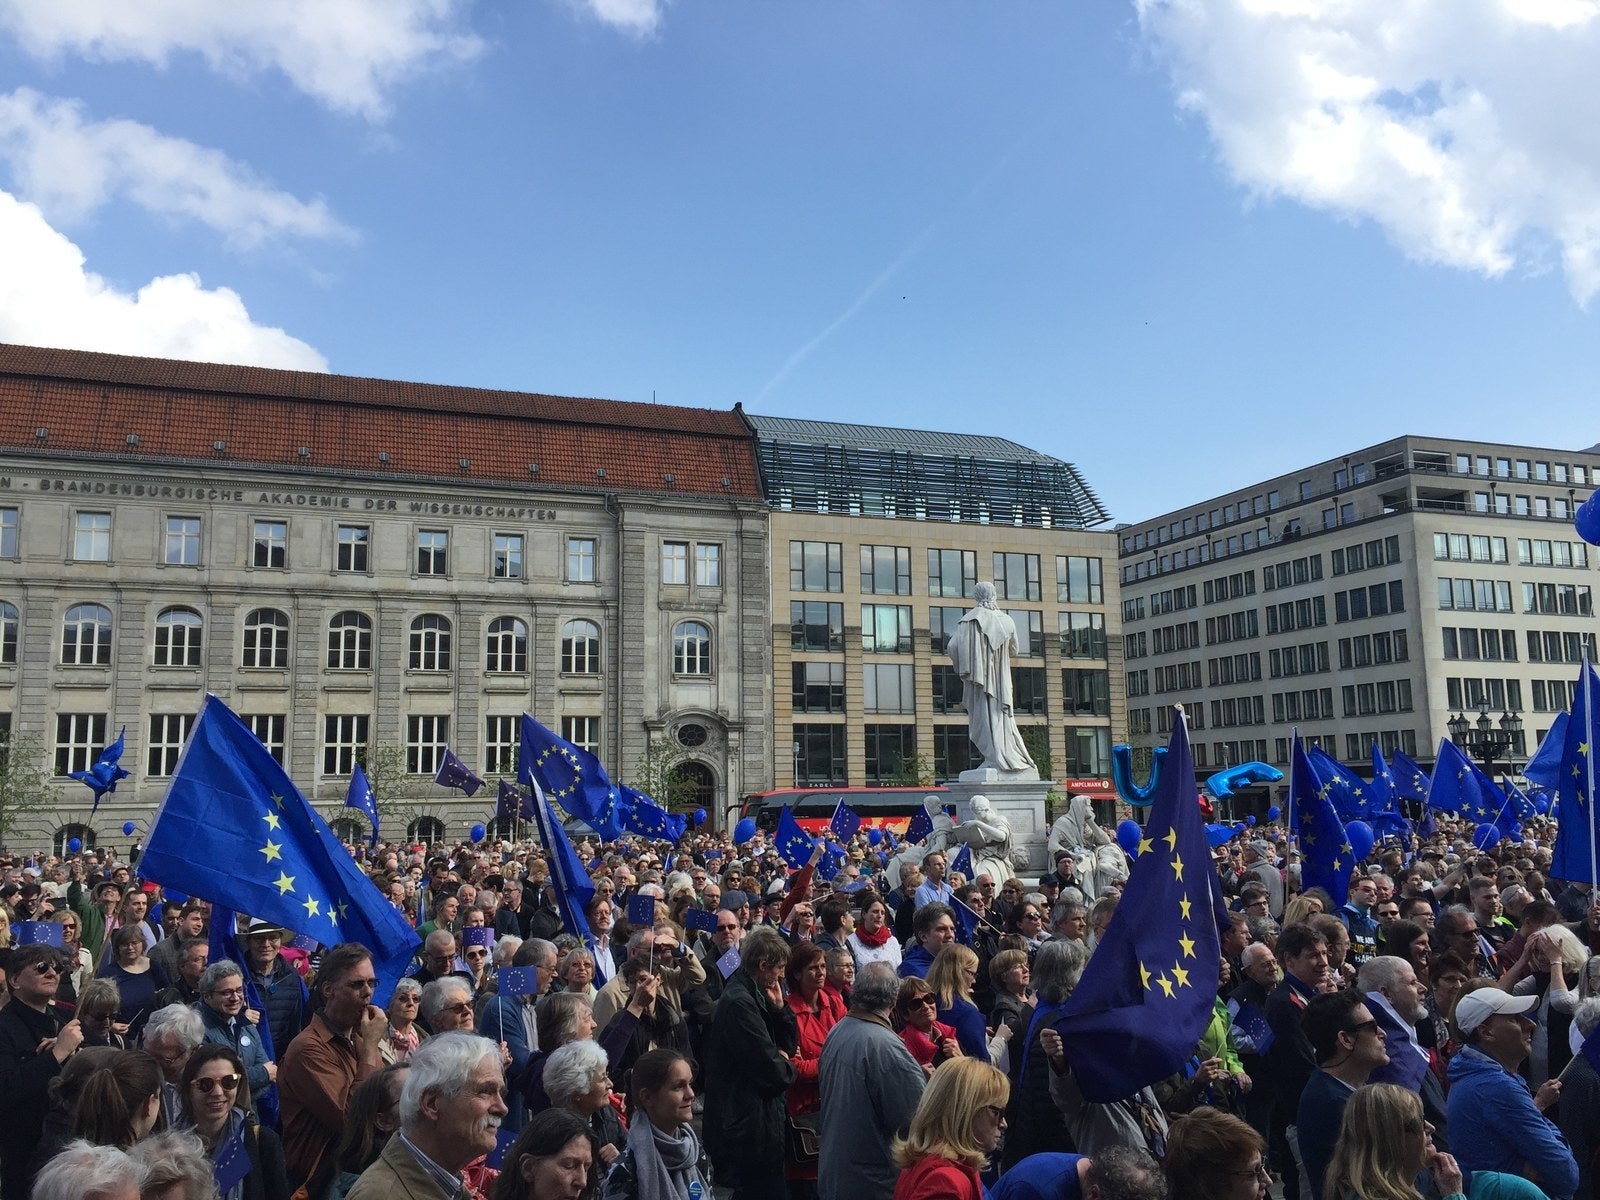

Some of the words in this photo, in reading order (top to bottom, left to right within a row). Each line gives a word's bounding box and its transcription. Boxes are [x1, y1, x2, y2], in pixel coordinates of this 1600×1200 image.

[39, 478, 243, 502] BRANDENBURGISCHE
[258, 492, 350, 509] AKADEMIE
[365, 498, 397, 512] DER
[410, 500, 557, 521] WISSENSCHAFTEN
[1355, 935, 1364, 944] WE
